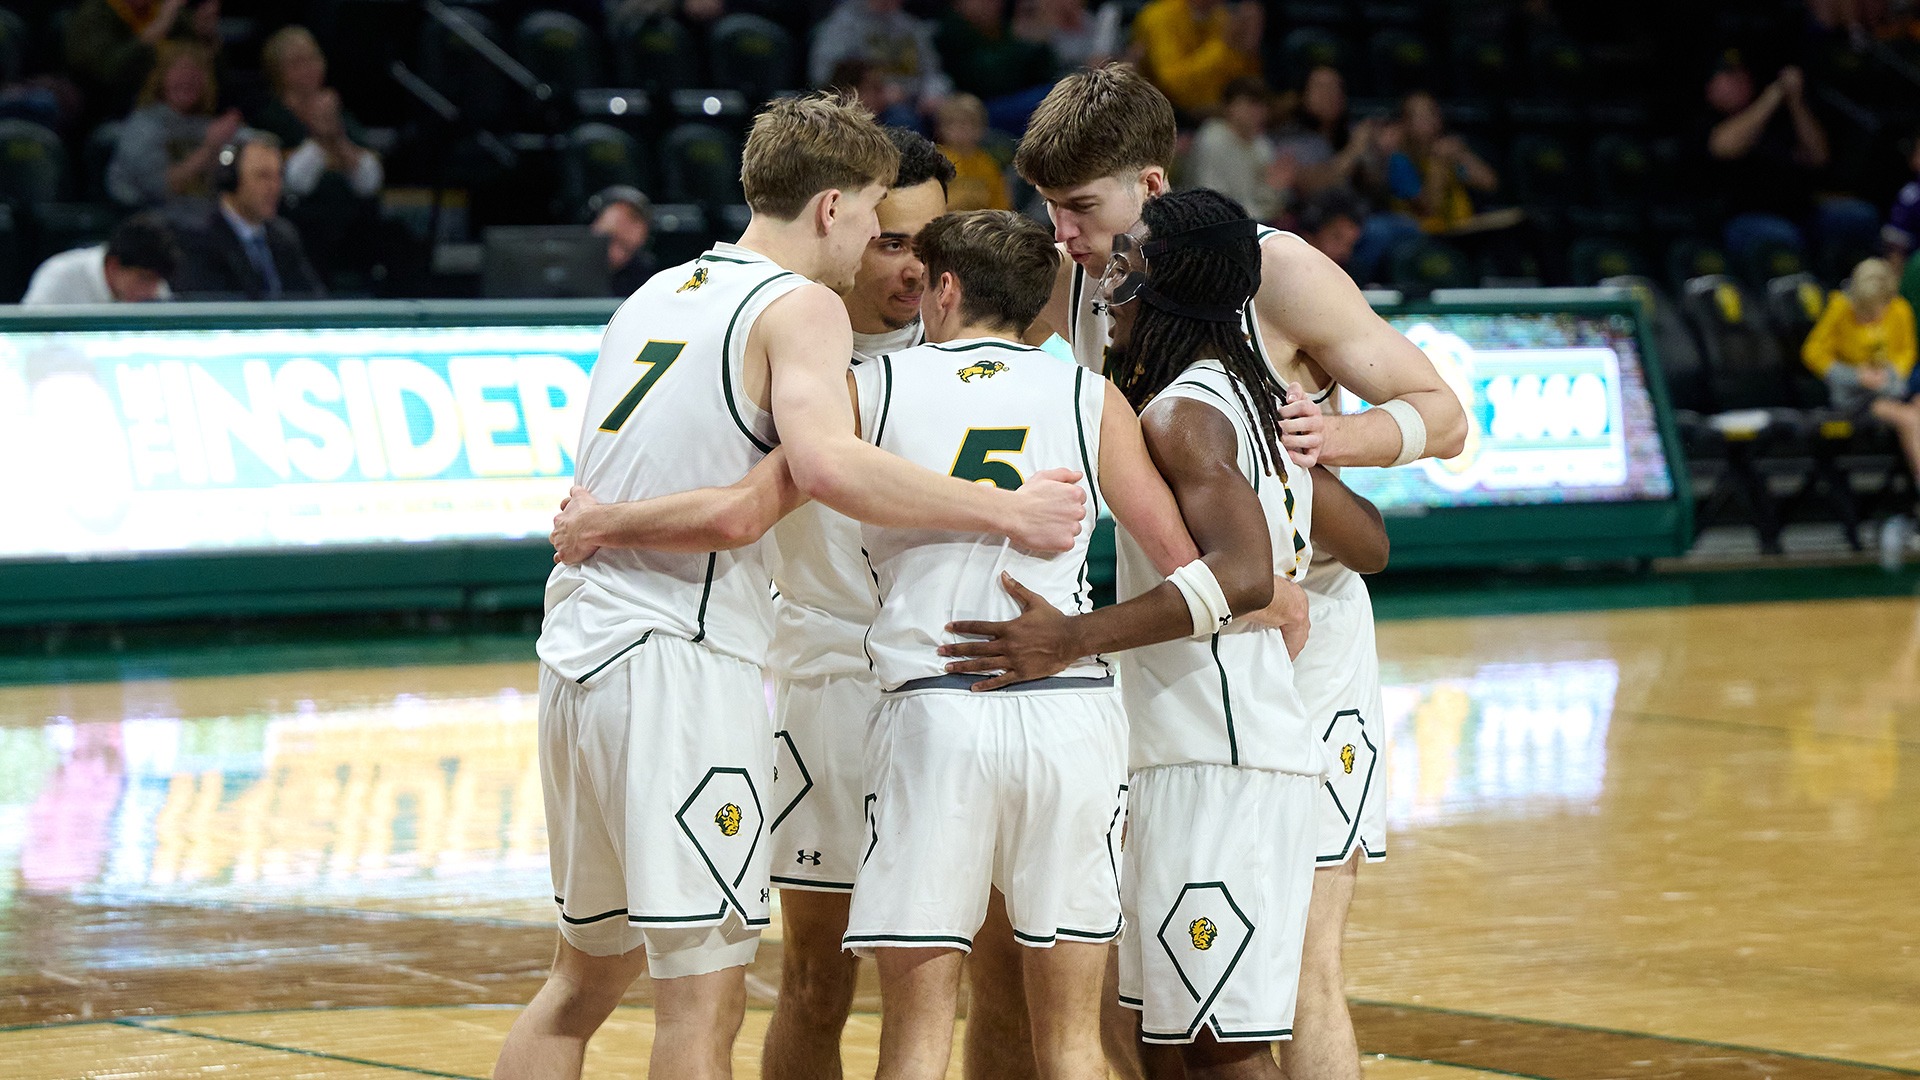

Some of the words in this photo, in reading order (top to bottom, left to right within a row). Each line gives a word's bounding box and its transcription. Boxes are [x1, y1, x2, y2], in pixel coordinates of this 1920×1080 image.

[159, 354, 595, 484] INSIDER
[598, 338, 689, 434] 7
[948, 426, 1031, 492] 5
